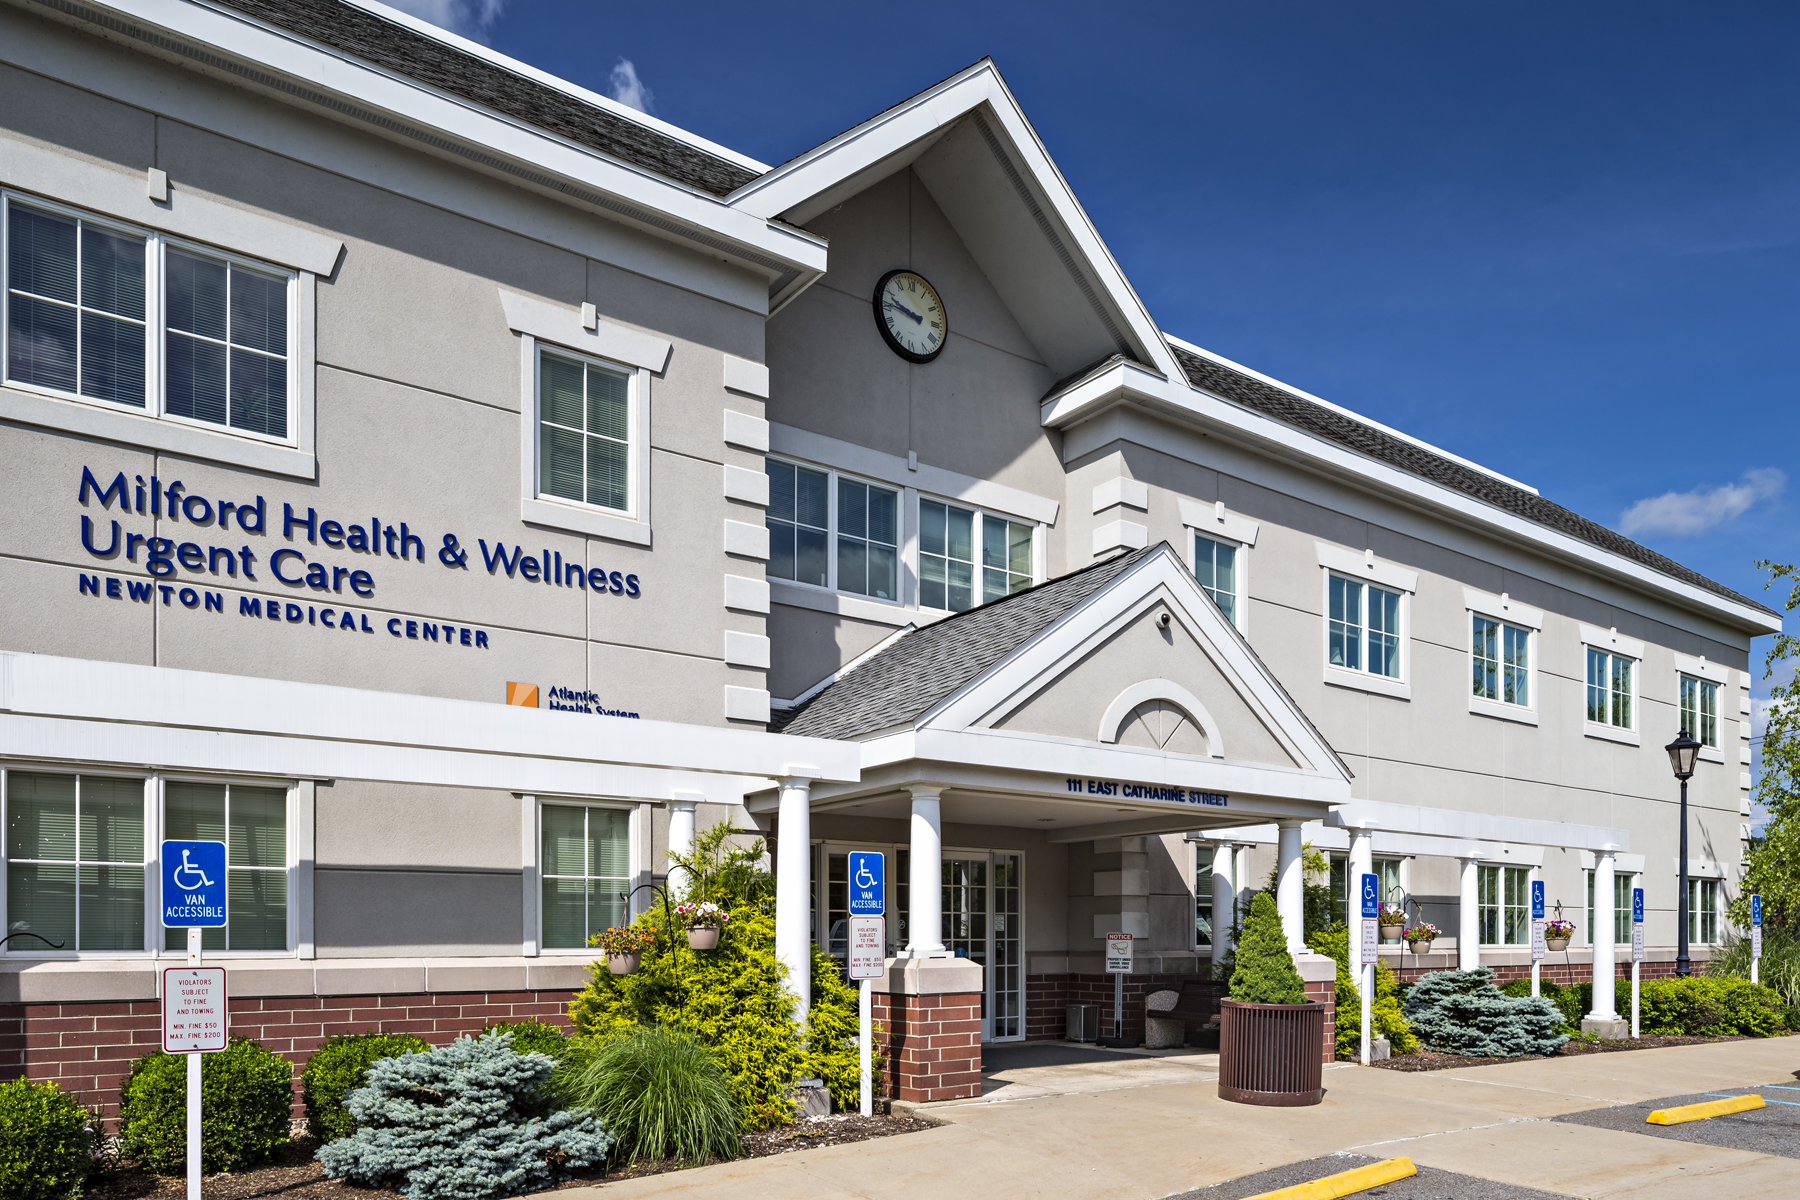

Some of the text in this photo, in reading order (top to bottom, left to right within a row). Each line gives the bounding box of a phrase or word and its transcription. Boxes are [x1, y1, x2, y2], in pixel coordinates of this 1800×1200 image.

[79, 466, 640, 595] Milford Health & Wellness
[81, 515, 373, 594] Urgent Care
[79, 573, 489, 648] NEWTON MEDICAL CENTER
[548, 685, 599, 703] Atlantic
[549, 700, 592, 714] Health
[1066, 778, 1229, 806] 111 EAST CATHARINE STREET
[184, 894, 205, 905] VAN
[861, 891, 873, 899] VAN
[851, 900, 882, 909] ACCESSIBLE
[166, 906, 223, 917] ACCESSIBLE
[181, 988, 209, 996] SUBJECT
[204, 1031, 221, 1039] $200
